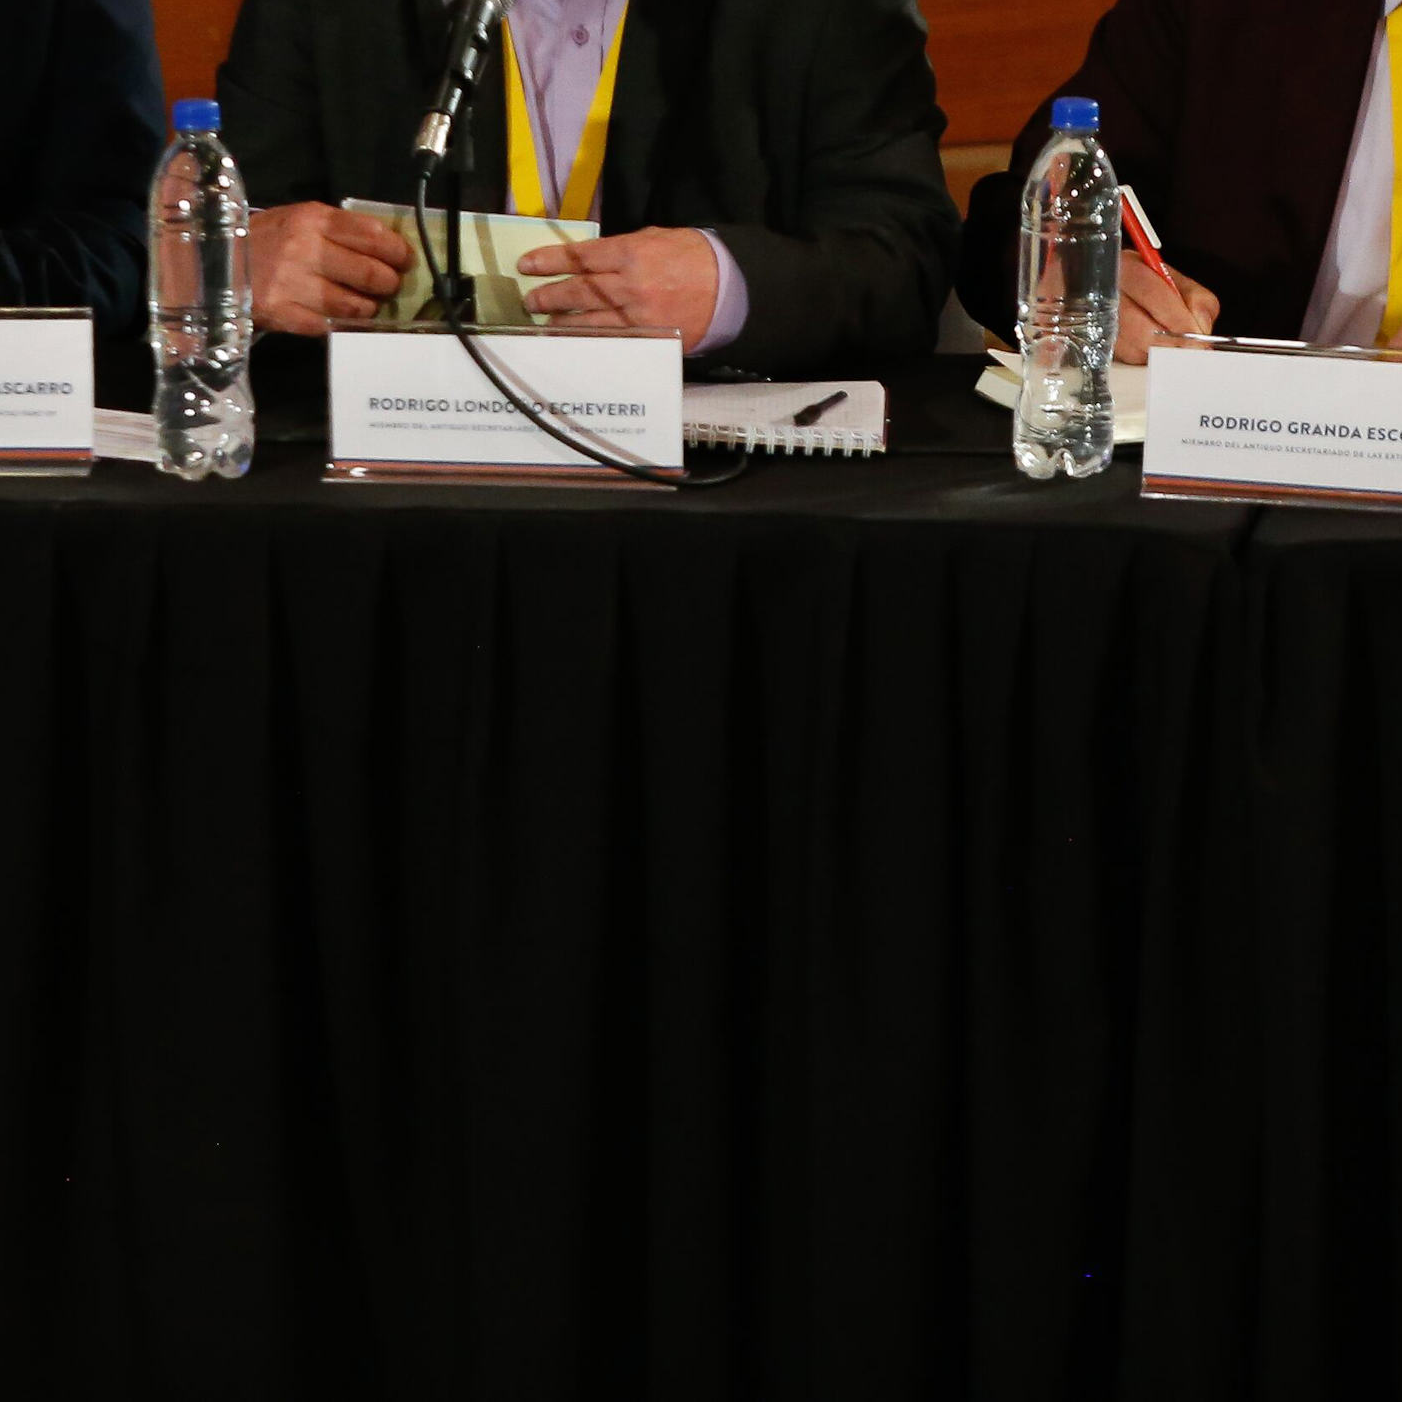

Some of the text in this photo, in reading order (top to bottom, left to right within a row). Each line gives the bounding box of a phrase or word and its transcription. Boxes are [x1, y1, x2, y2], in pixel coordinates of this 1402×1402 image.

[369, 397, 646, 417] RODRIGO LONDOO ECHEVERRI
[1199, 414, 1283, 433] RODRIGO
[1288, 421, 1362, 439] GRANDA
[1181, 438, 1223, 448] MIEMBRO
[1224, 441, 1241, 449] DEL
[1352, 450, 1364, 458] DE
